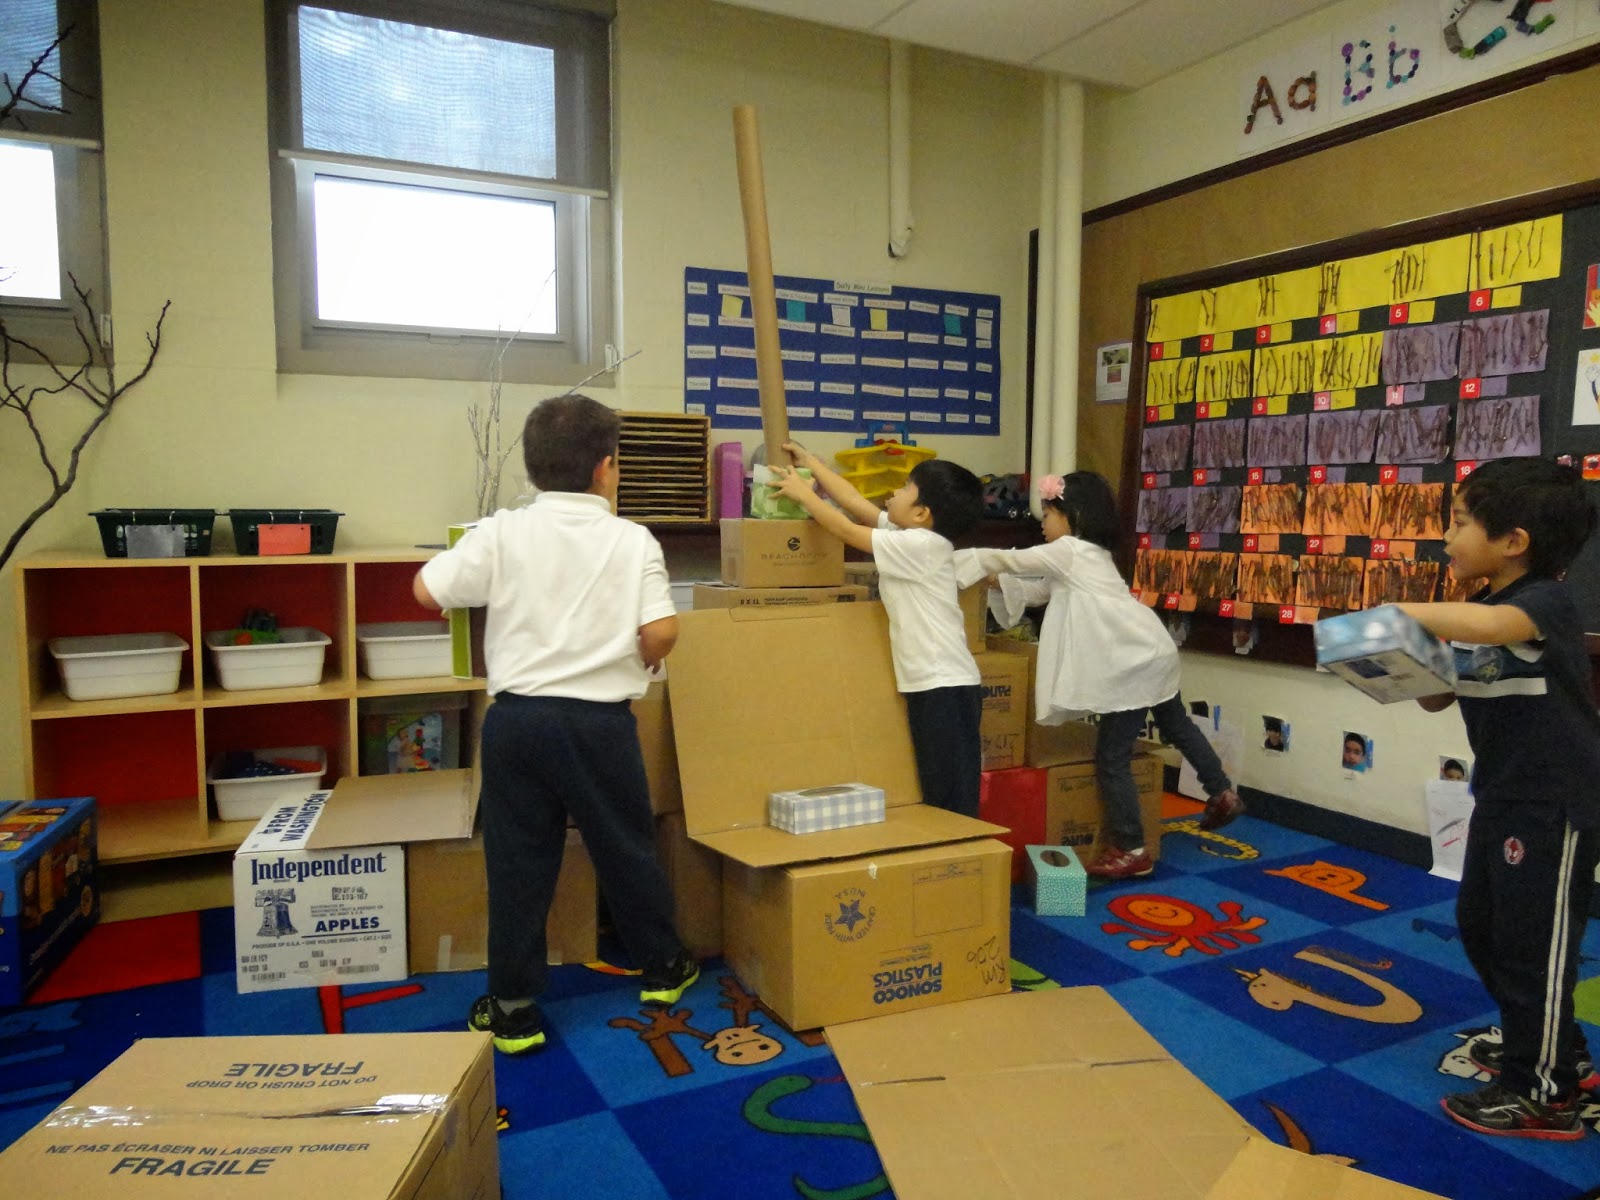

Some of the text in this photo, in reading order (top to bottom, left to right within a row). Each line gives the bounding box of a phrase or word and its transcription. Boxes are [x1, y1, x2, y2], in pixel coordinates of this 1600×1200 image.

[1244, 71, 1317, 135] Aa
[1475, 297, 1483, 307] 6
[1395, 309, 1402, 318] 5
[1324, 320, 1331, 329] 4
[1260, 330, 1267, 338] 3
[1204, 339, 1210, 347] 2
[1154, 347, 1159, 355] 1
[1465, 383, 1475, 393] 12
[1391, 391, 1398, 399] 11
[1317, 396, 1326, 405] 10
[1200, 405, 1206, 413] 8
[1257, 403, 1263, 411] 9
[1150, 410, 1155, 418] 7
[1313, 471, 1322, 479] 16
[1384, 470, 1393, 479] 17
[1460, 466, 1472, 476] 18
[1251, 472, 1259, 480] 15
[1190, 536, 1199, 544] 20
[1246, 539, 1254, 547] 21
[1309, 540, 1319, 548] 22
[1374, 544, 1385, 553] 23
[1221, 603, 1232, 612] 27
[1282, 609, 1293, 619] 28
[267, 806, 299, 828] FROM
[279, 793, 329, 842] WASHINGTON
[250, 852, 387, 886] Independent
[314, 916, 380, 933] APPLES
[834, 931, 854, 942] WITH
[872, 962, 942, 988] PLASTICS
[872, 979, 942, 1005] SONOCO
[226, 1061, 365, 1077] FRAGILE
[186, 1076, 377, 1090] DO NOT CRUSH OR DROP
[45, 1142, 371, 1157] NE PAS ÉCRASER NI LAISSER TOMBER
[109, 1157, 275, 1177] FRAGILE
